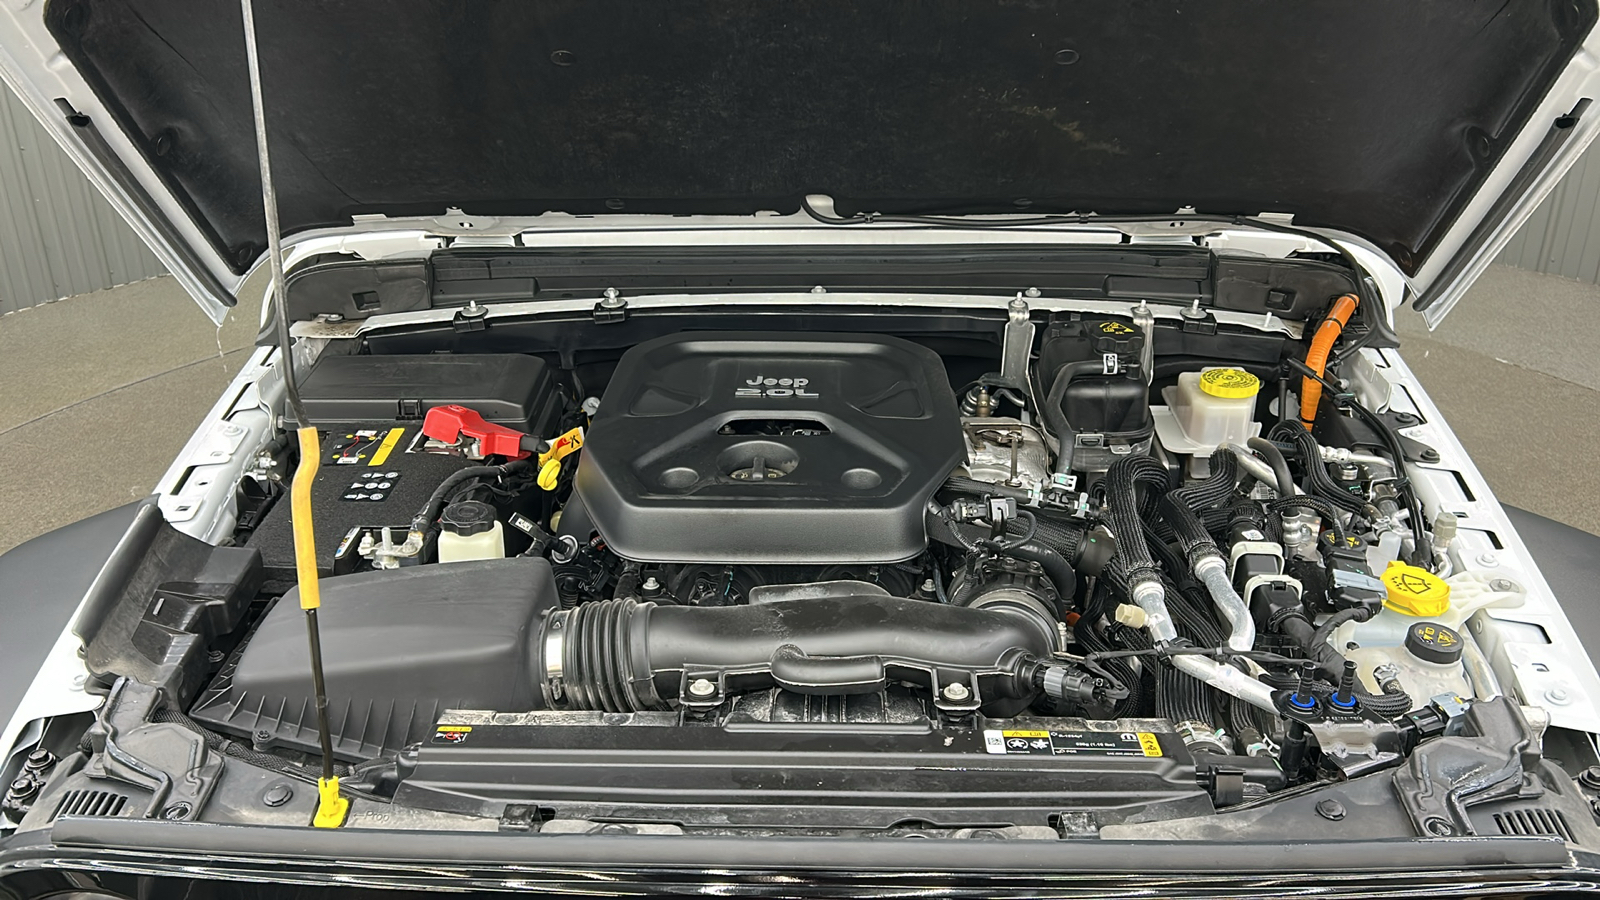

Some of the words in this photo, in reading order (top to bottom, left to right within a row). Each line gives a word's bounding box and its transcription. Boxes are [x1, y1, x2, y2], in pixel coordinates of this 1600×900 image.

[746, 375, 808, 388] Jeep
[735, 388, 819, 398] 2.0L
[365, 810, 389, 823] Prop
